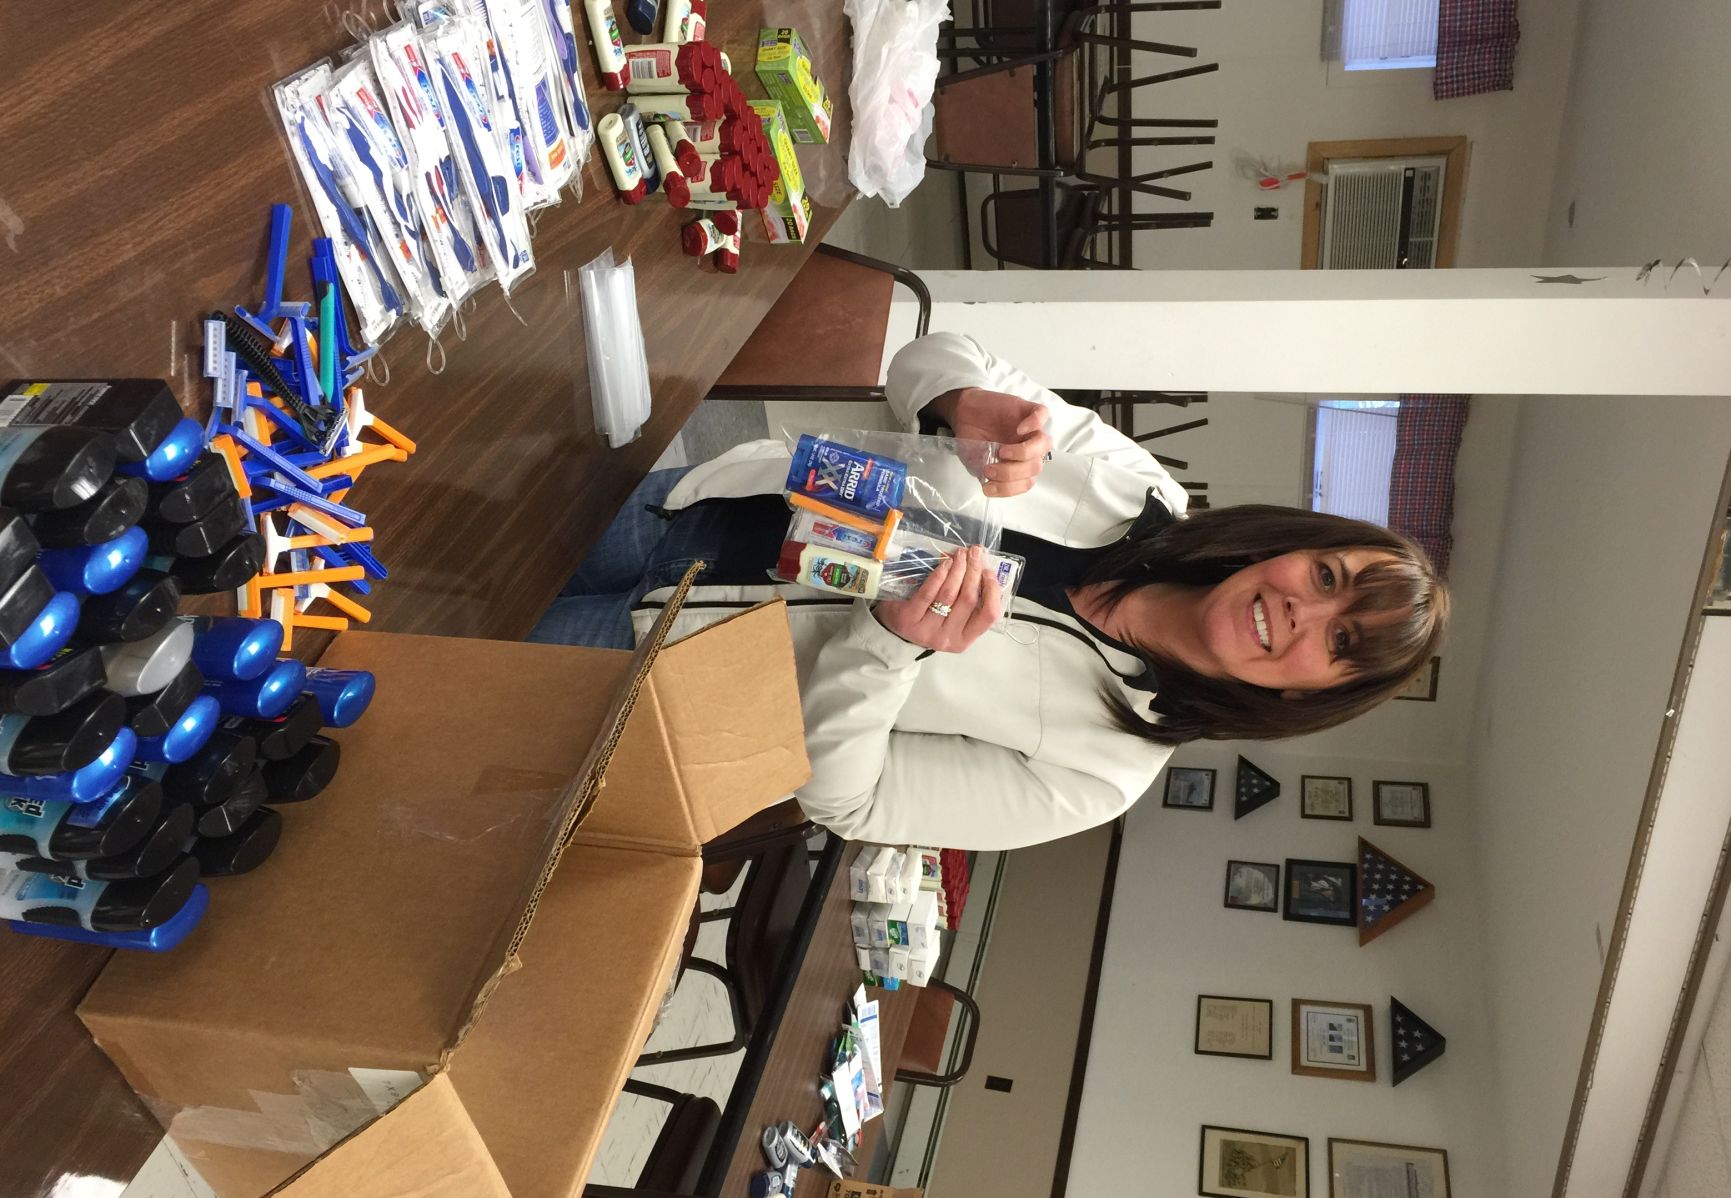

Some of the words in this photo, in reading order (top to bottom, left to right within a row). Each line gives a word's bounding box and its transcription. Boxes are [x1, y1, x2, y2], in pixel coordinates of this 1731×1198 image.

[514, 135, 522, 168] Crest
[773, 182, 782, 195] SIZE
[844, 461, 865, 500] ARRID
[875, 469, 885, 492] FORMULA
